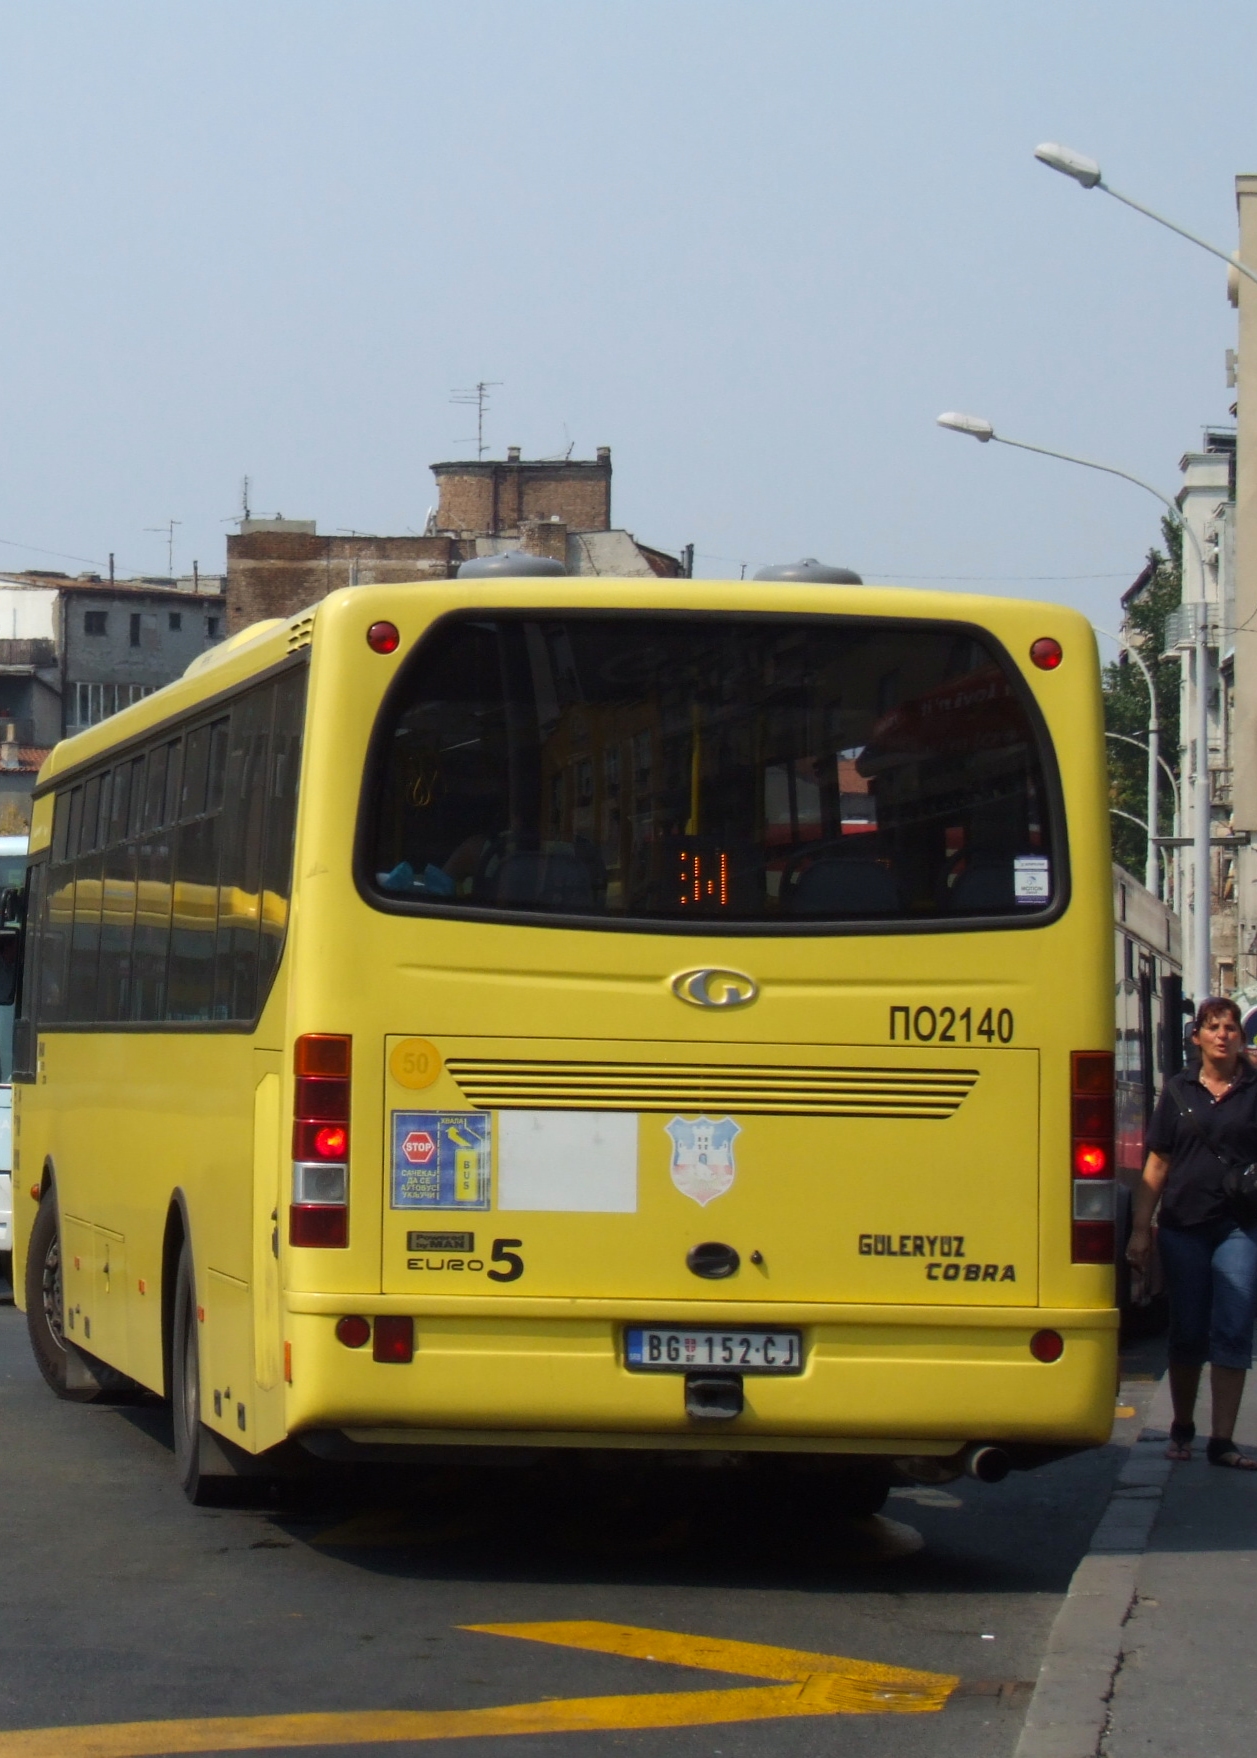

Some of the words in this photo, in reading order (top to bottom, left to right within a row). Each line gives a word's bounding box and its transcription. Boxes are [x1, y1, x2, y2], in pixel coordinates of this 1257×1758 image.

[403, 1052, 429, 1075] 50
[406, 1142, 431, 1152] STOP
[430, 1241, 464, 1249] MAN
[407, 1258, 484, 1271] EURO
[486, 1238, 524, 1283] 5
[925, 1262, 1016, 1282] COBRA
[648, 1334, 680, 1362] BG
